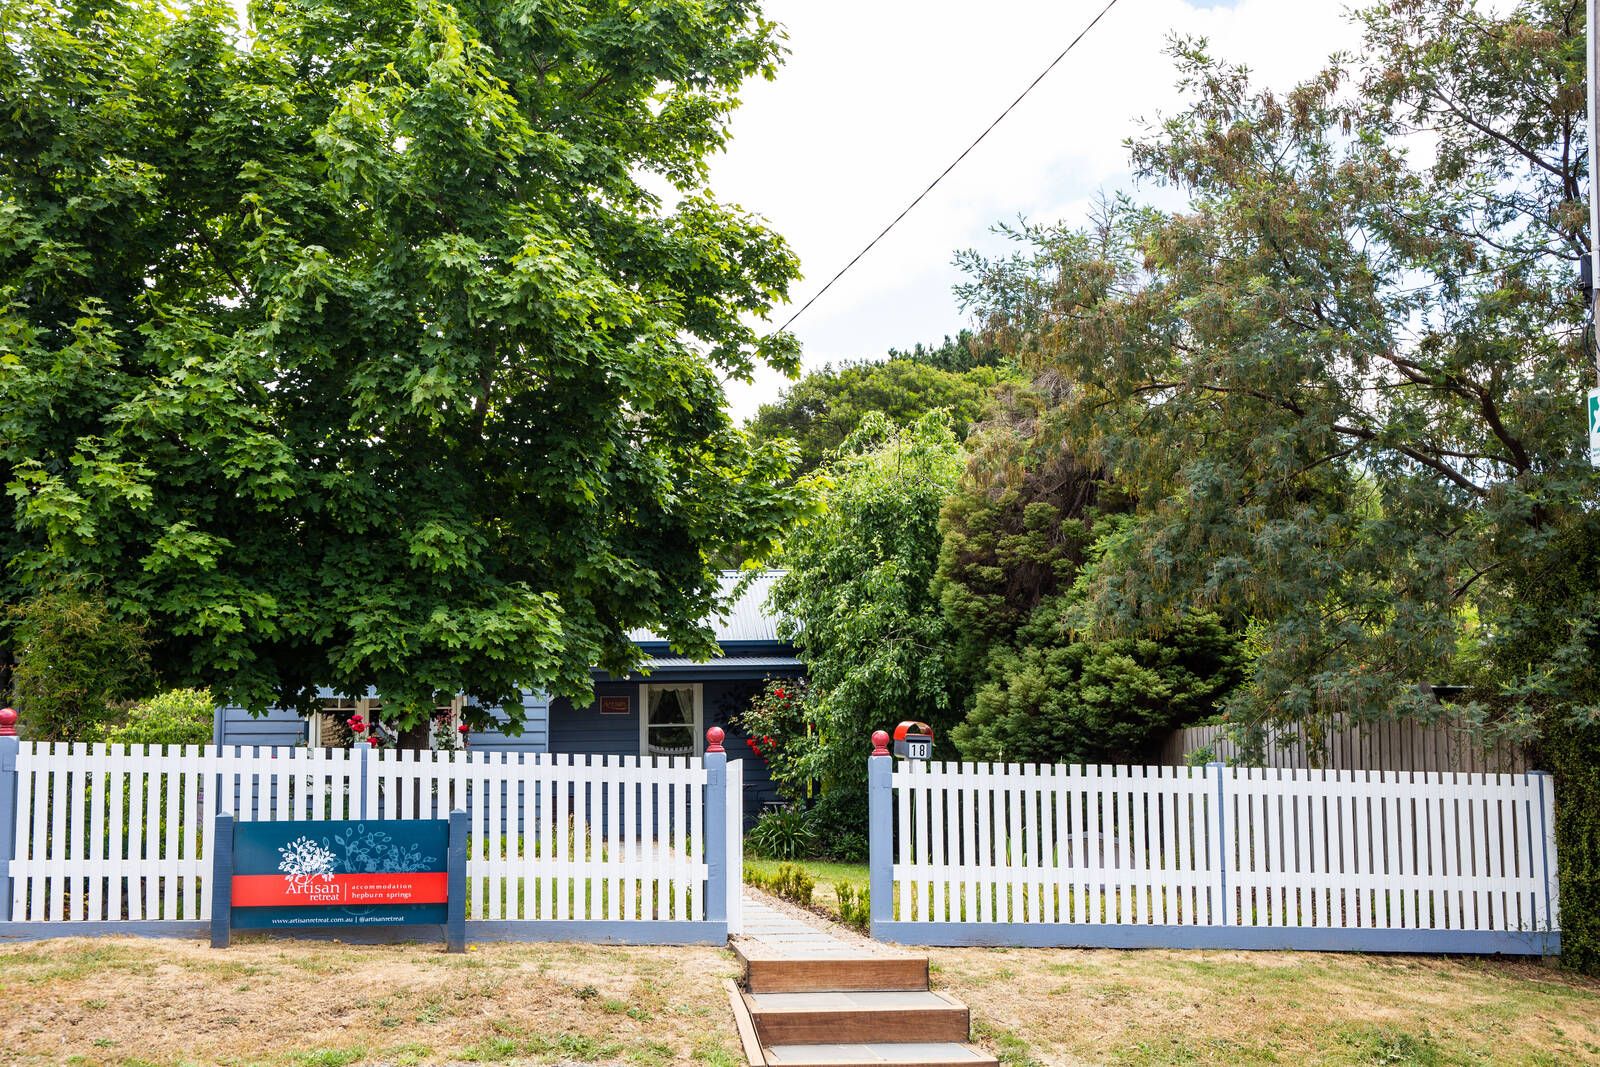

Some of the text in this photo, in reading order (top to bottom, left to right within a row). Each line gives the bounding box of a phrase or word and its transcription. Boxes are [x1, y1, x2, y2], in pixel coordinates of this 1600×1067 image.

[911, 744, 925, 757] 18
[285, 881, 340, 894] Artisan
[310, 893, 339, 901] retreat
[351, 892, 412, 900] hepburn springs
